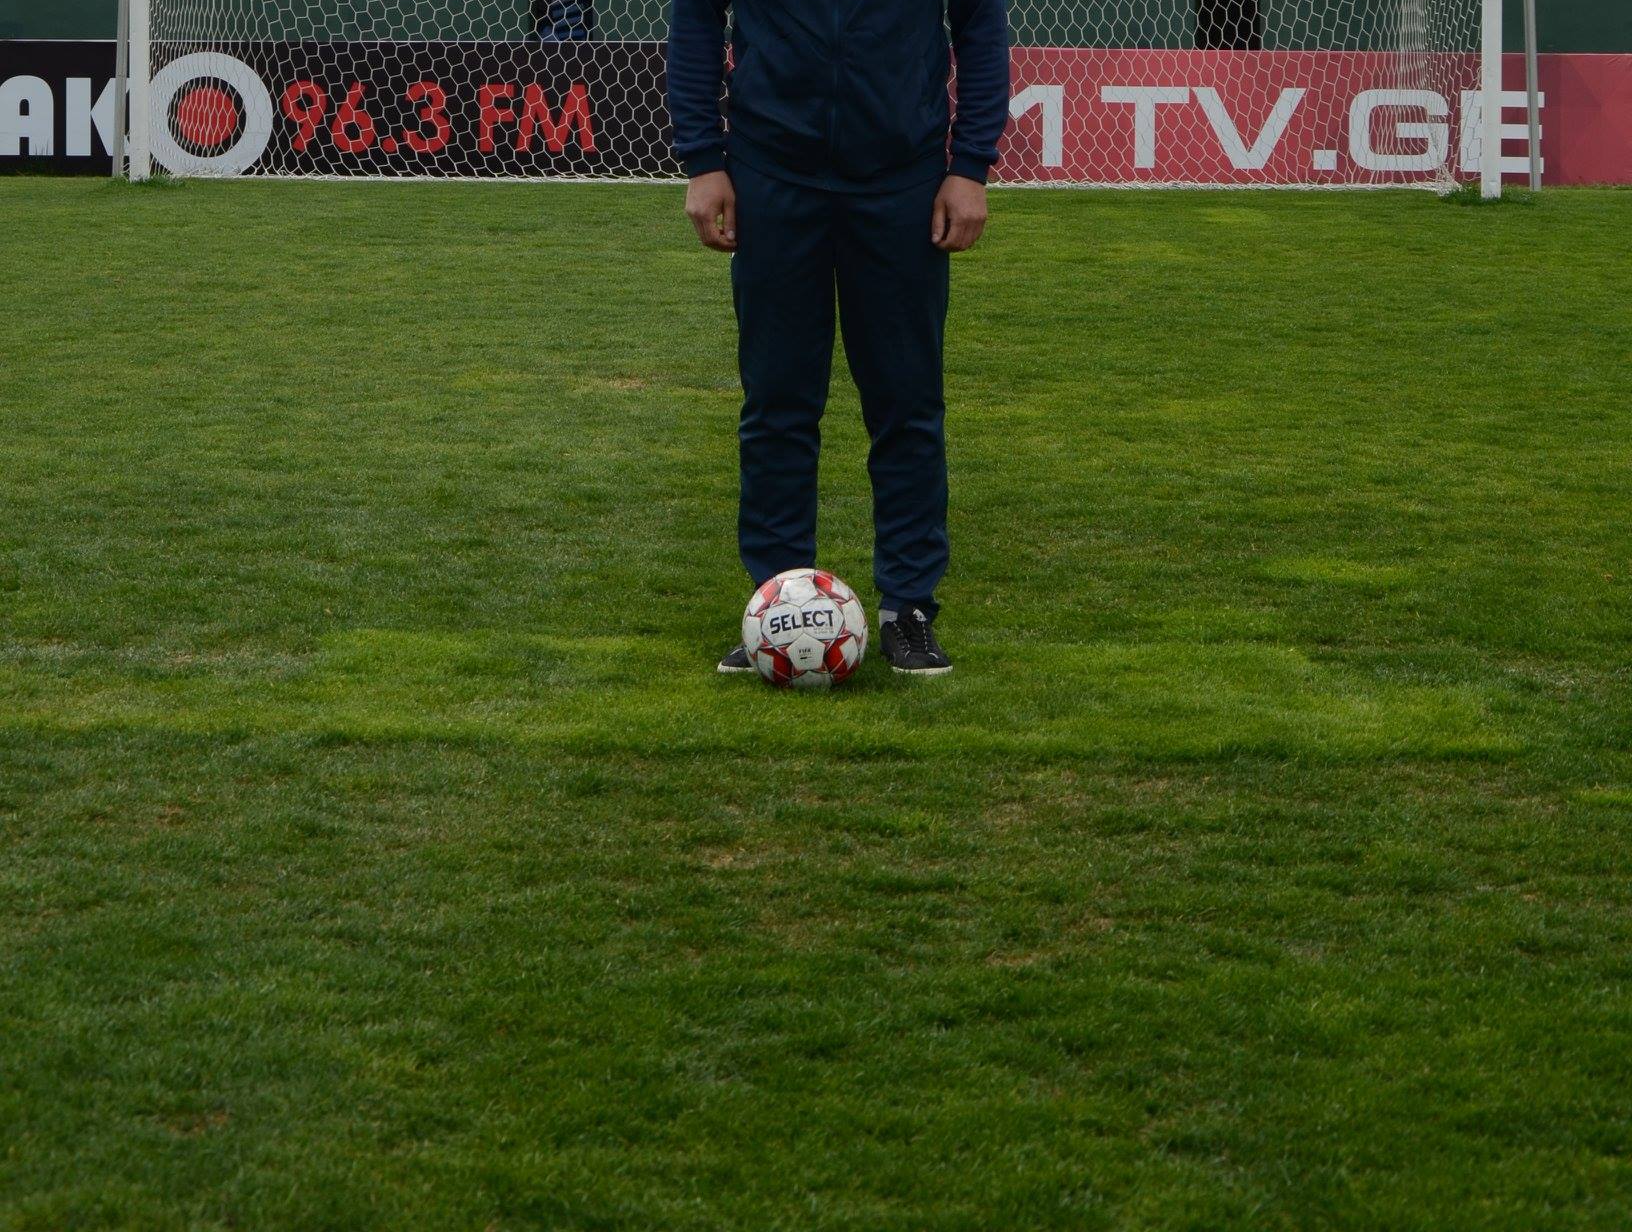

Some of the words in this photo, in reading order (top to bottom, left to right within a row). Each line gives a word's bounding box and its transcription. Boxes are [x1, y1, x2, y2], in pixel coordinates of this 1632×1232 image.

[282, 80, 452, 154] 96.3
[478, 83, 599, 153] FM
[1009, 84, 1545, 174] 1TV.GE
[769, 609, 834, 635] SELECT
